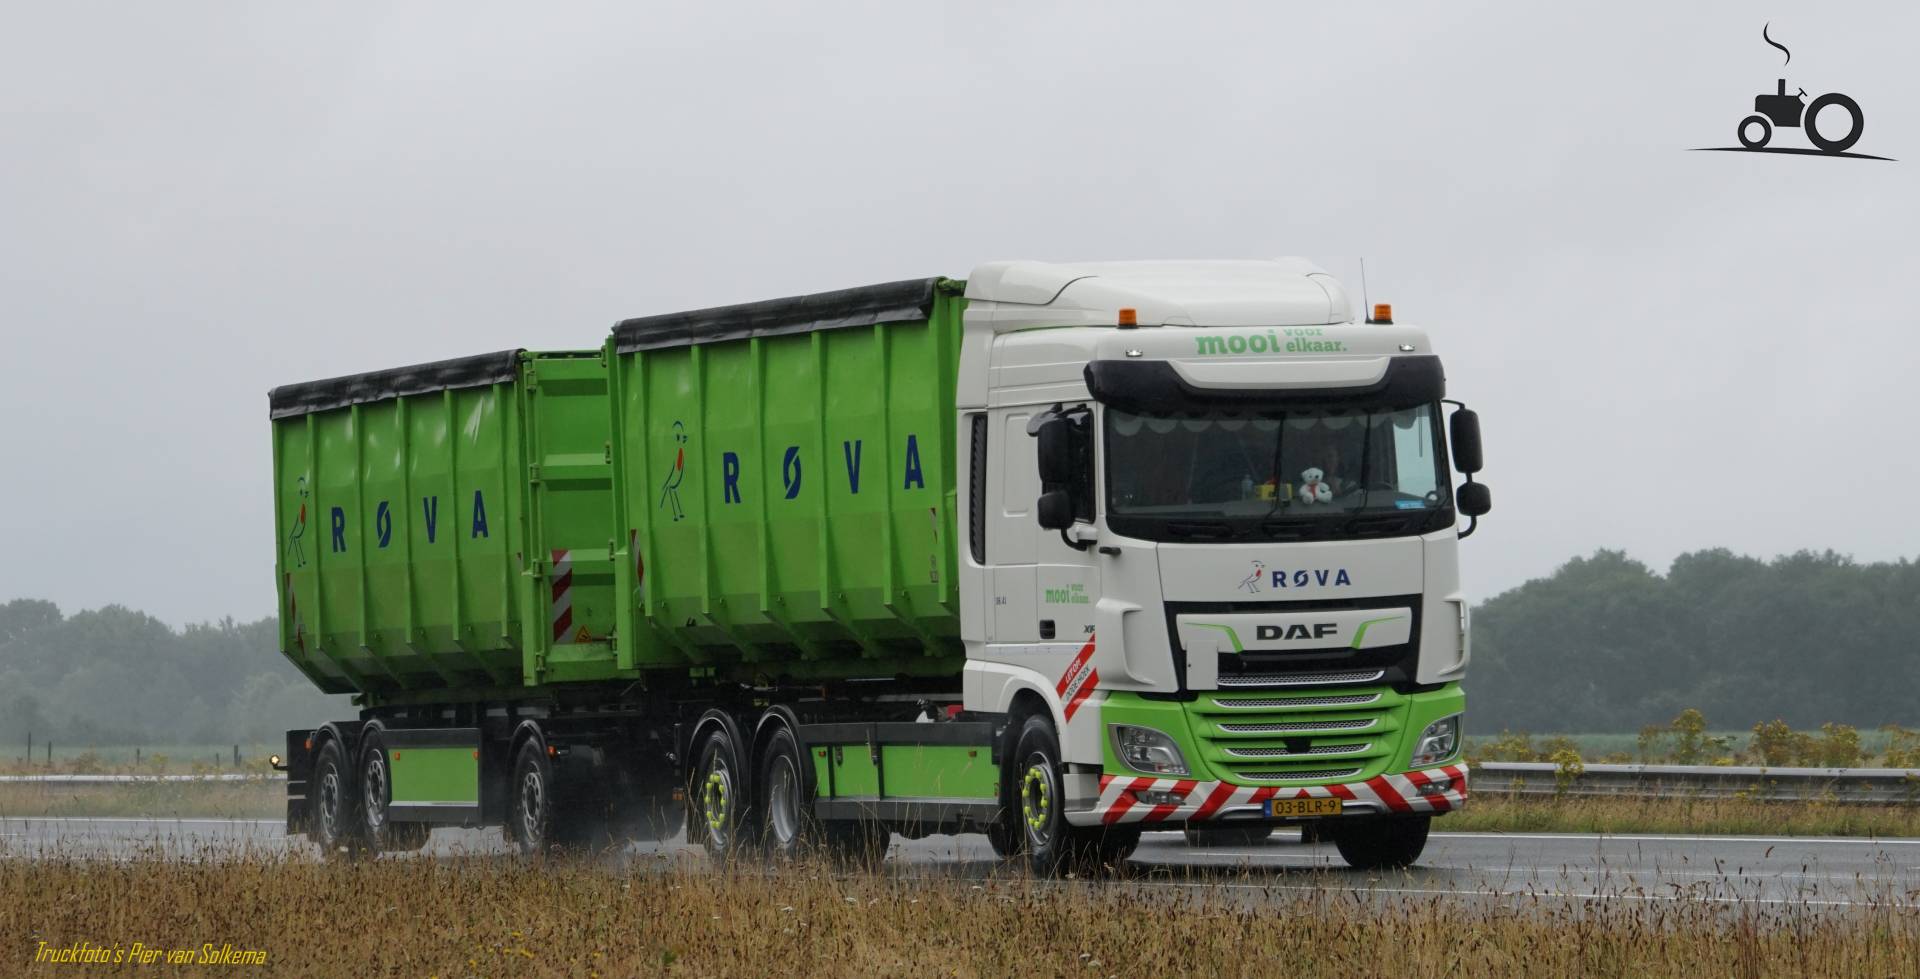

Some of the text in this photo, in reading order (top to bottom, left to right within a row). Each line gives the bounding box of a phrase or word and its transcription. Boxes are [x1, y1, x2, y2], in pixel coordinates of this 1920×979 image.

[1283, 327, 1323, 336] voor
[1195, 329, 1281, 355] mooi
[1286, 337, 1347, 352] elkaar.
[1272, 569, 1352, 588] RØVA
[1045, 584, 1071, 603] mooi
[1256, 623, 1337, 640] DAF
[1275, 800, 1337, 815] 03-BLR-9
